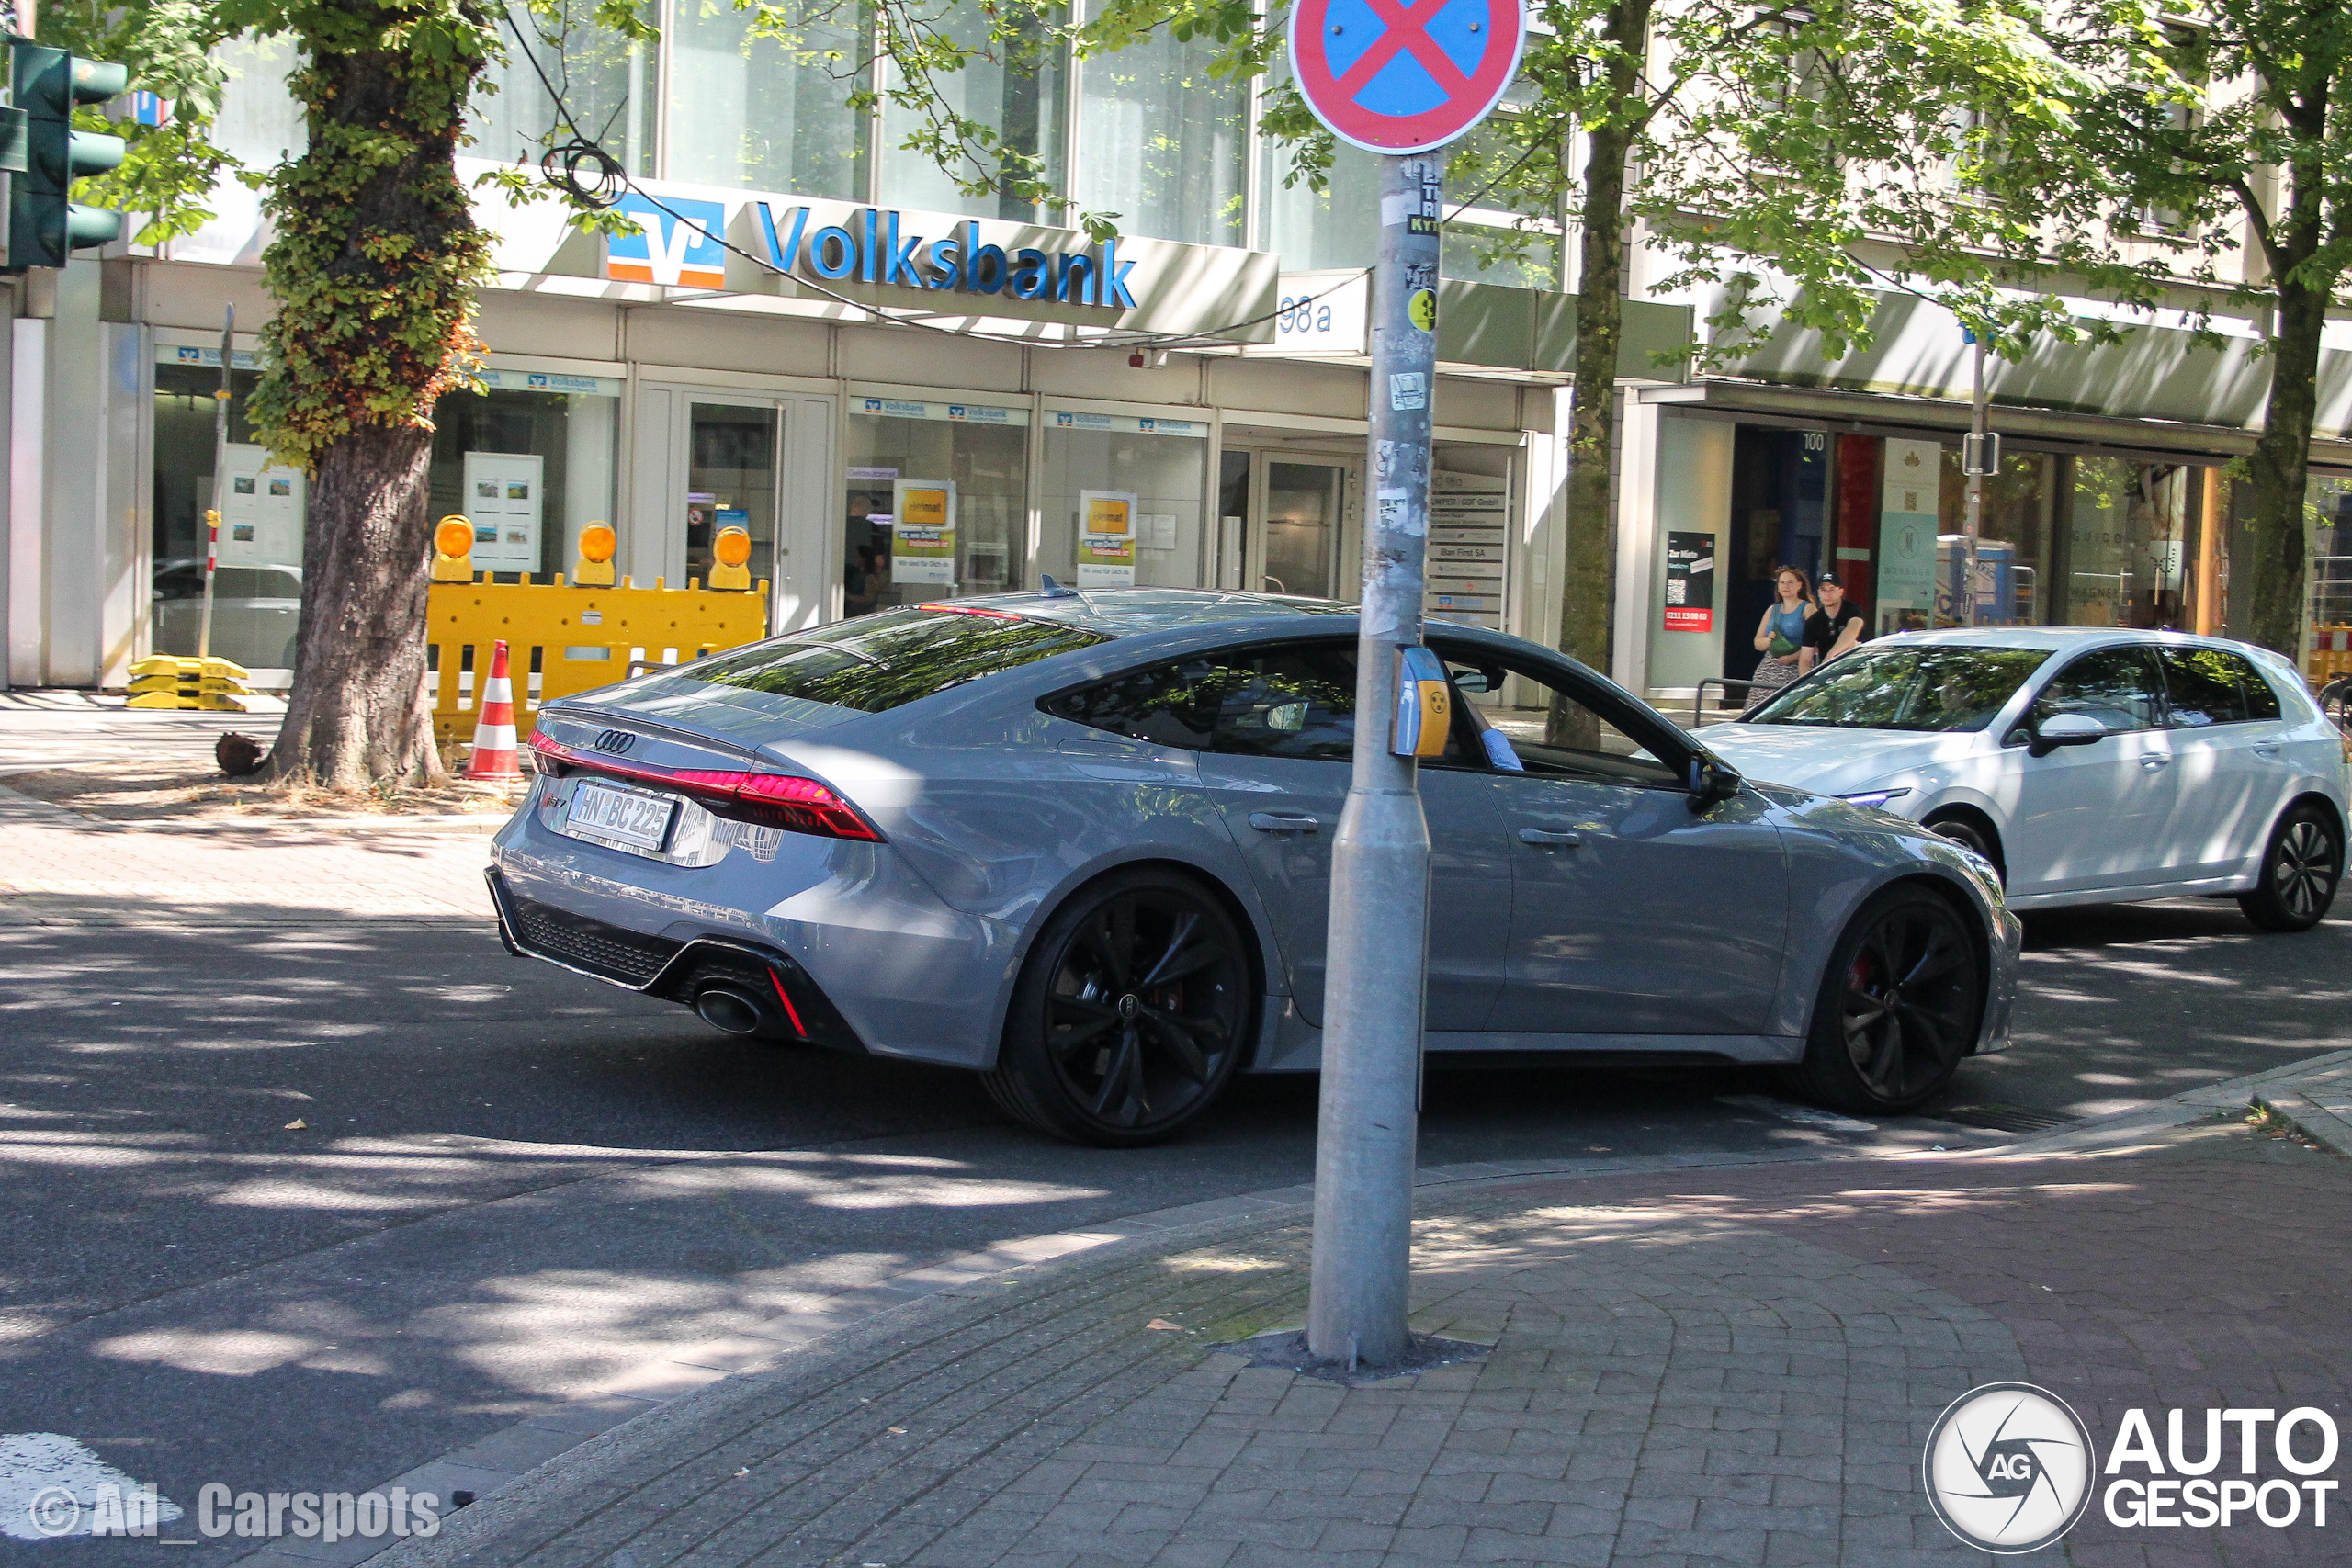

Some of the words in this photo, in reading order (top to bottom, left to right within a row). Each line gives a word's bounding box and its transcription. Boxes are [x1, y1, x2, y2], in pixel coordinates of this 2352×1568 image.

[755, 201, 1137, 310] Volksbank
[552, 376, 596, 387] Volksbank
[884, 401, 924, 412] Volksbank
[967, 408, 1007, 418] Volksbank
[1076, 415, 1110, 424] Volksbank
[1158, 421, 1192, 430] Volksbank
[1804, 433, 1824, 451] 100
[909, 501, 941, 513] Heimat
[2073, 532, 2122, 544] GUIDO
[578, 788, 605, 823] HN
[605, 795, 635, 829] BC
[628, 801, 669, 838] 225
